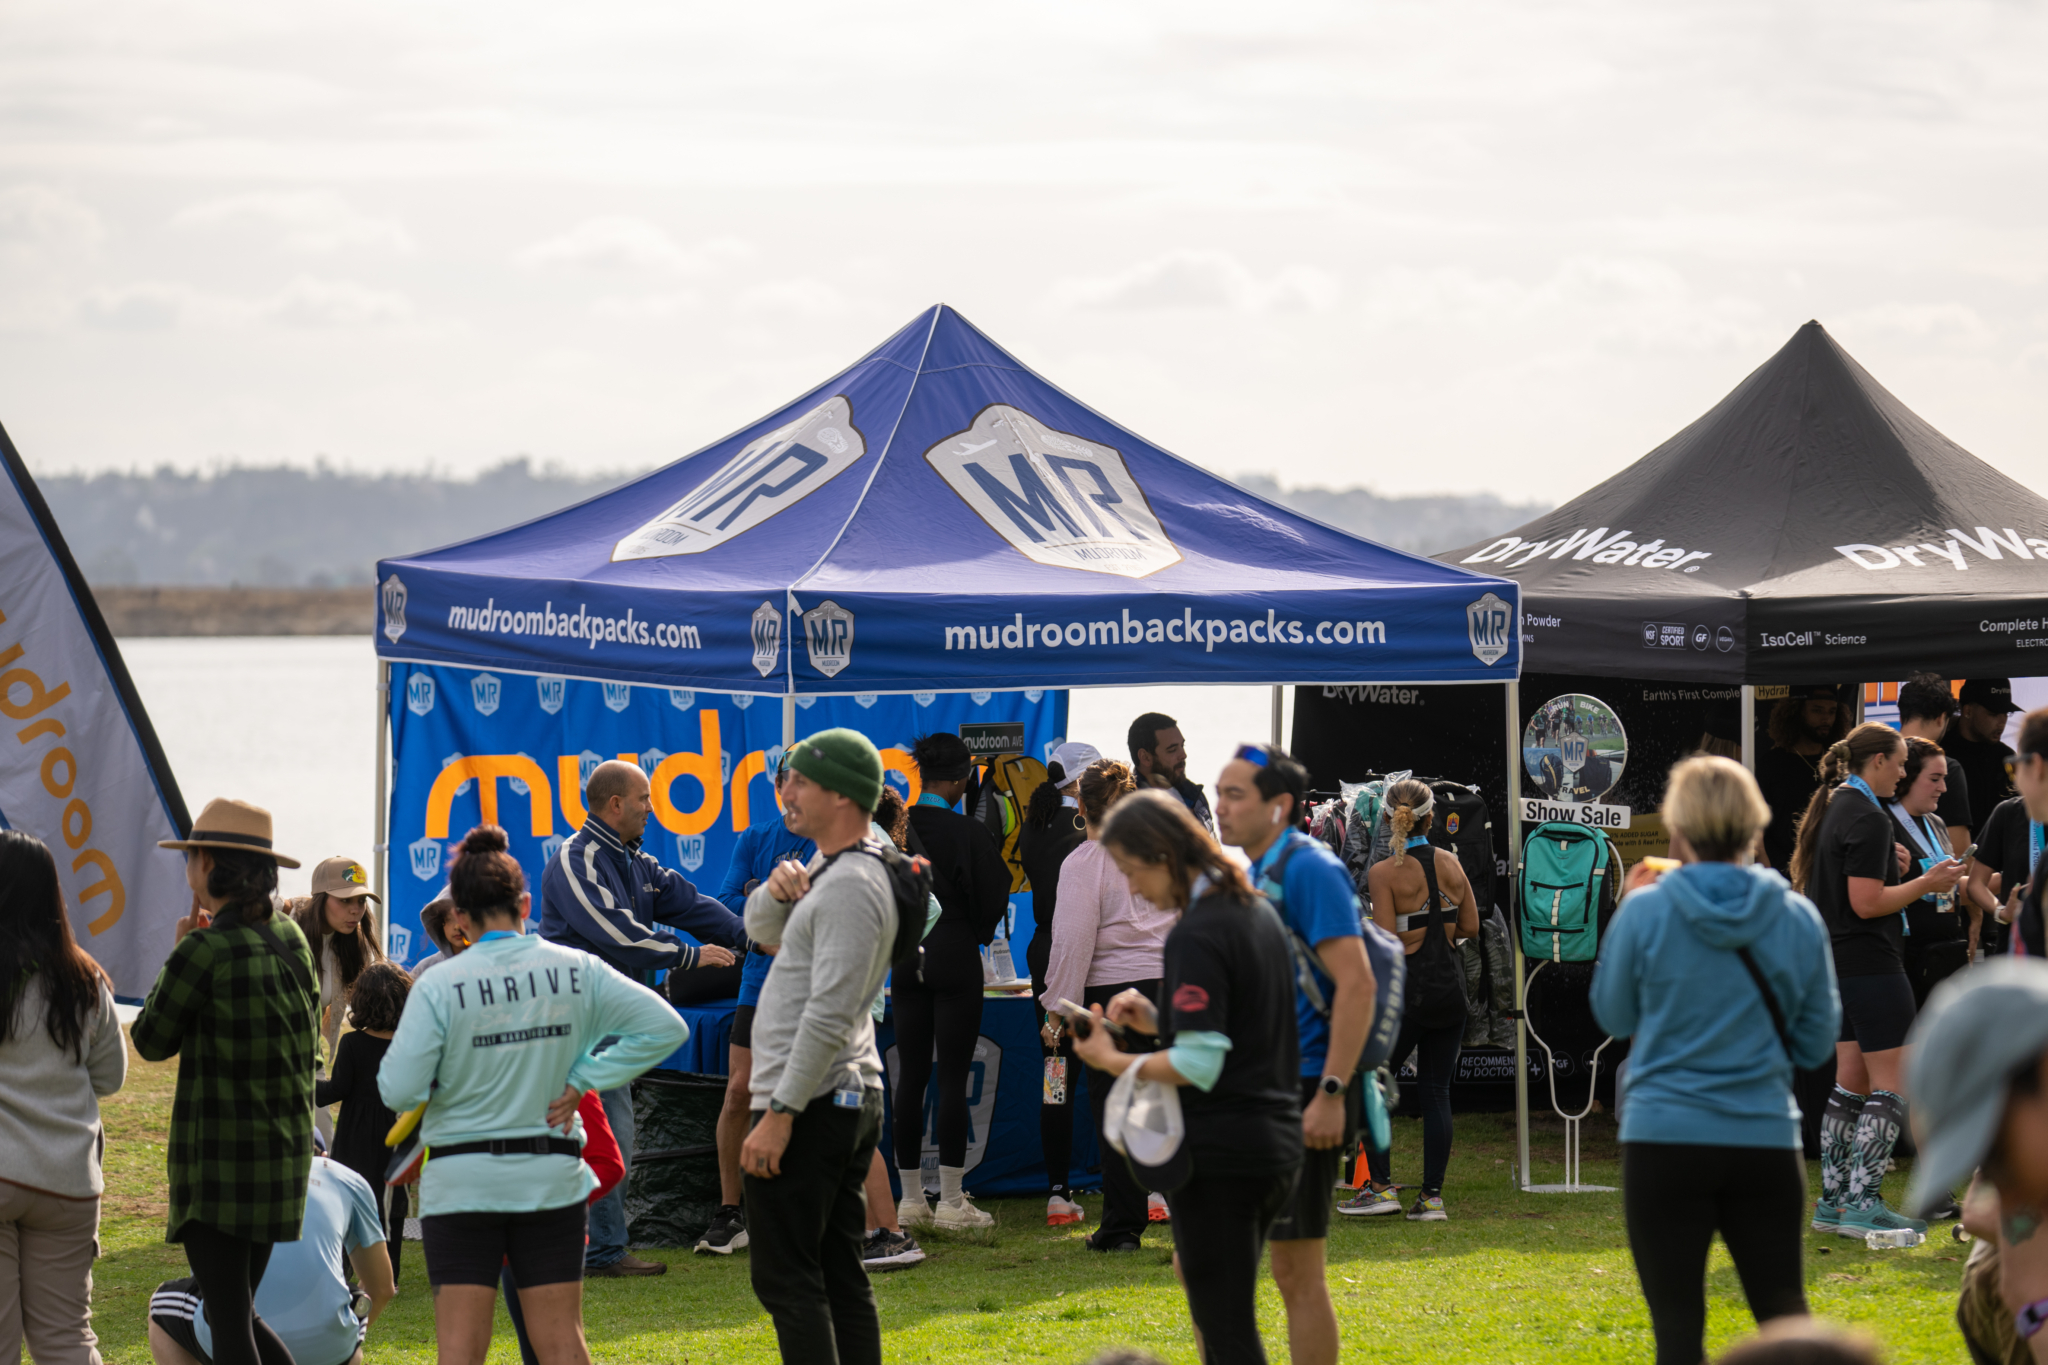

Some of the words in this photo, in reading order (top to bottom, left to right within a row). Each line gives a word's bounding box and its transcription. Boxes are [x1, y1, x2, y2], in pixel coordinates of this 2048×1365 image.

[962, 453, 1152, 543] MR
[448, 598, 701, 650] mudroombackpacks.com
[944, 607, 1386, 652] mudroombackpacks.com
[1472, 610, 1506, 646] MR
[1527, 613, 1561, 628] Powder
[1662, 626, 1685, 635] CERTIFIED
[1979, 618, 2039, 634] Complete
[755, 619, 778, 656] MR
[810, 619, 848, 656] MR
[1645, 630, 1656, 641] NSF
[1660, 635, 1685, 647] SPORT
[1695, 633, 1708, 643] GF
[1825, 633, 1867, 646] Science
[409, 682, 431, 704] MR
[475, 682, 498, 704] MR
[541, 681, 562, 703] MR
[1643, 690, 1677, 701] Earth's
[1678, 689, 1701, 700] First
[1552, 700, 1570, 712] RUN
[1579, 701, 1600, 714] BIKE
[963, 730, 1010, 750] mudroom
[1012, 735, 1023, 747] AVE
[1564, 741, 1585, 761] MR
[1526, 801, 1576, 821] Show
[1581, 805, 1622, 827] Sale
[414, 847, 437, 869] MR
[681, 839, 701, 860] MR
[453, 966, 582, 1009] THRIVE
[474, 1036, 497, 1047] HALF
[500, 1027, 549, 1044] MARATHON
[1460, 1068, 1472, 1079] by
[1556, 1060, 1568, 1069] GF
